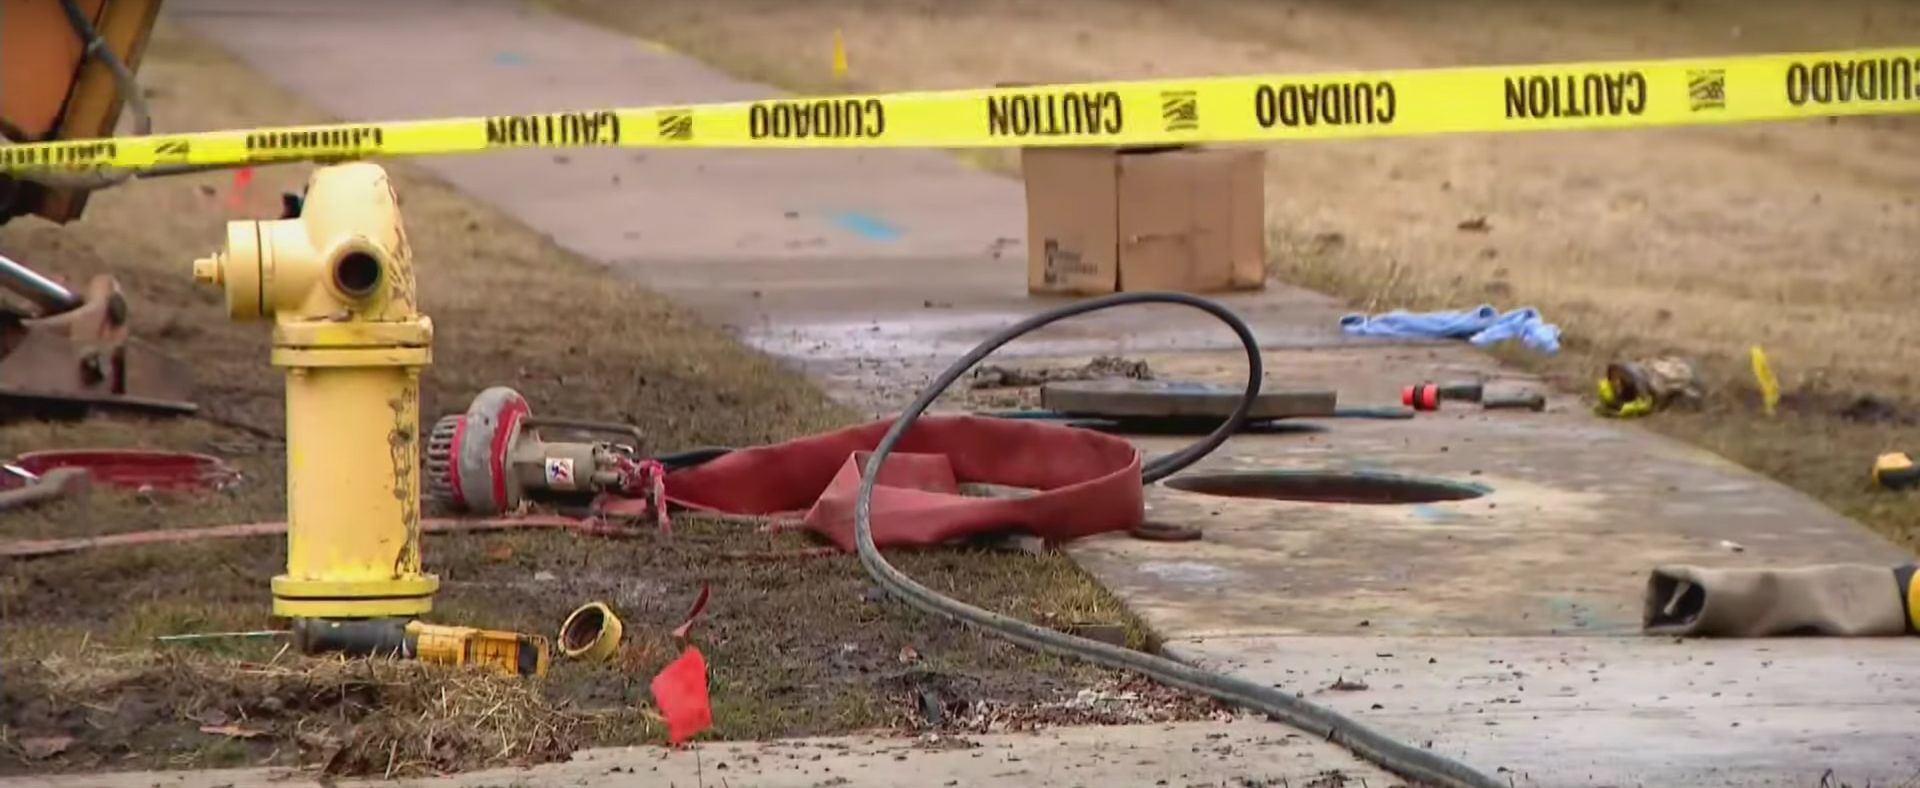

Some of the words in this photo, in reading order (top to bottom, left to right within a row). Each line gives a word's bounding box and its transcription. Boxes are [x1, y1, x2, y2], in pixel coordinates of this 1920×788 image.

[749, 99, 884, 138] CUIDADO
[988, 91, 1122, 136] CAUTION
[1255, 81, 1396, 128] CUIDADO
[1505, 72, 1646, 119] CAUTION
